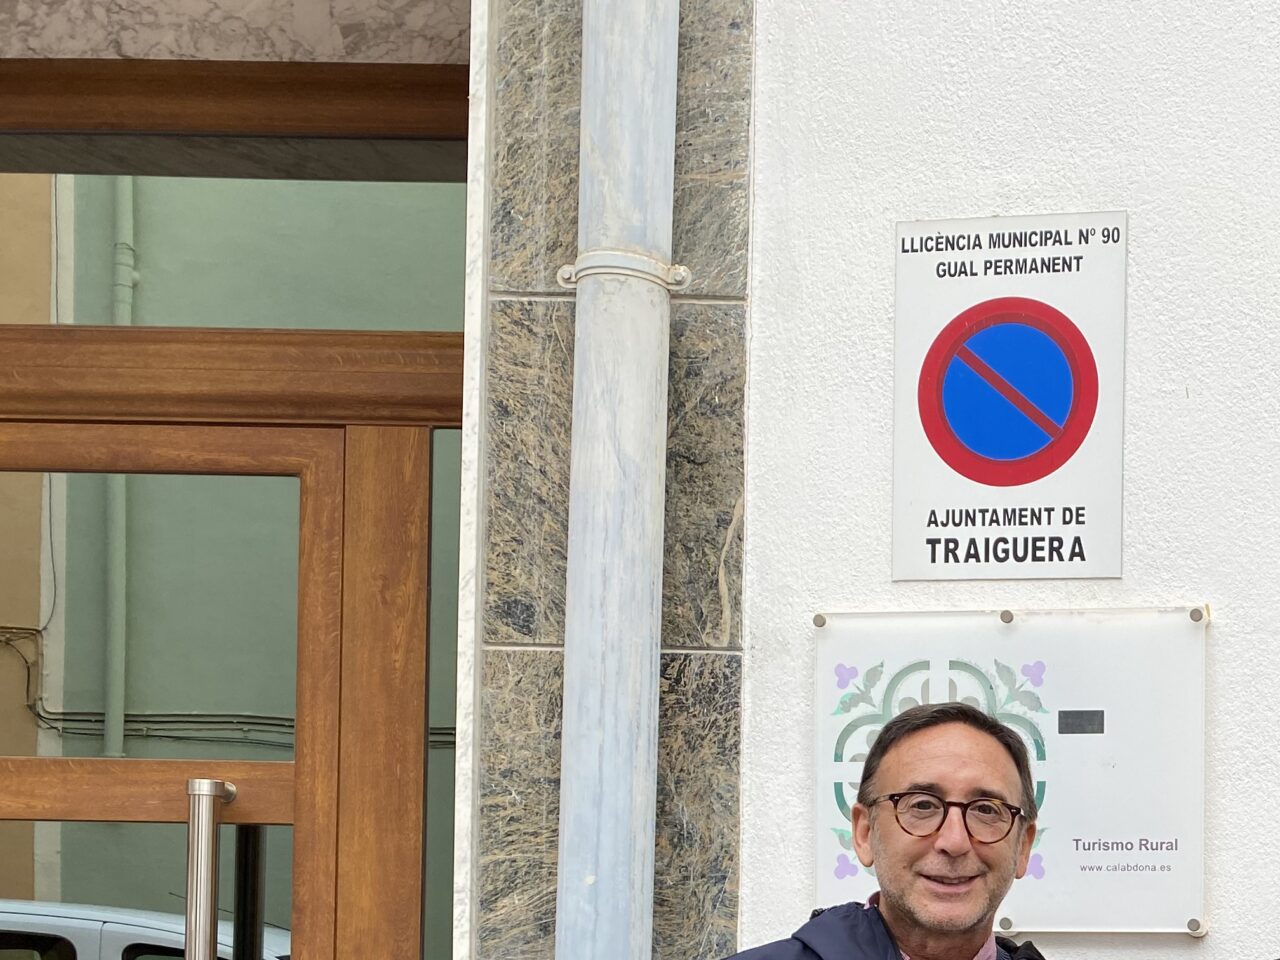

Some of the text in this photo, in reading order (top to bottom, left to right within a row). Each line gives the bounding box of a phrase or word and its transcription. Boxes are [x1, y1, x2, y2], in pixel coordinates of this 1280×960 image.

[901, 232, 983, 253] LLICÈNCIA
[988, 229, 1073, 249] MUNICIPAL
[1101, 226, 1121, 244] 90
[936, 256, 1084, 278] GUAL PERMANENT
[927, 506, 1086, 527] AJUNTAMENT DE
[926, 535, 1087, 564] TRAIGUERA
[1072, 838, 1179, 852] Turismo Rural
[1080, 863, 1172, 872] www.calabdona.es
